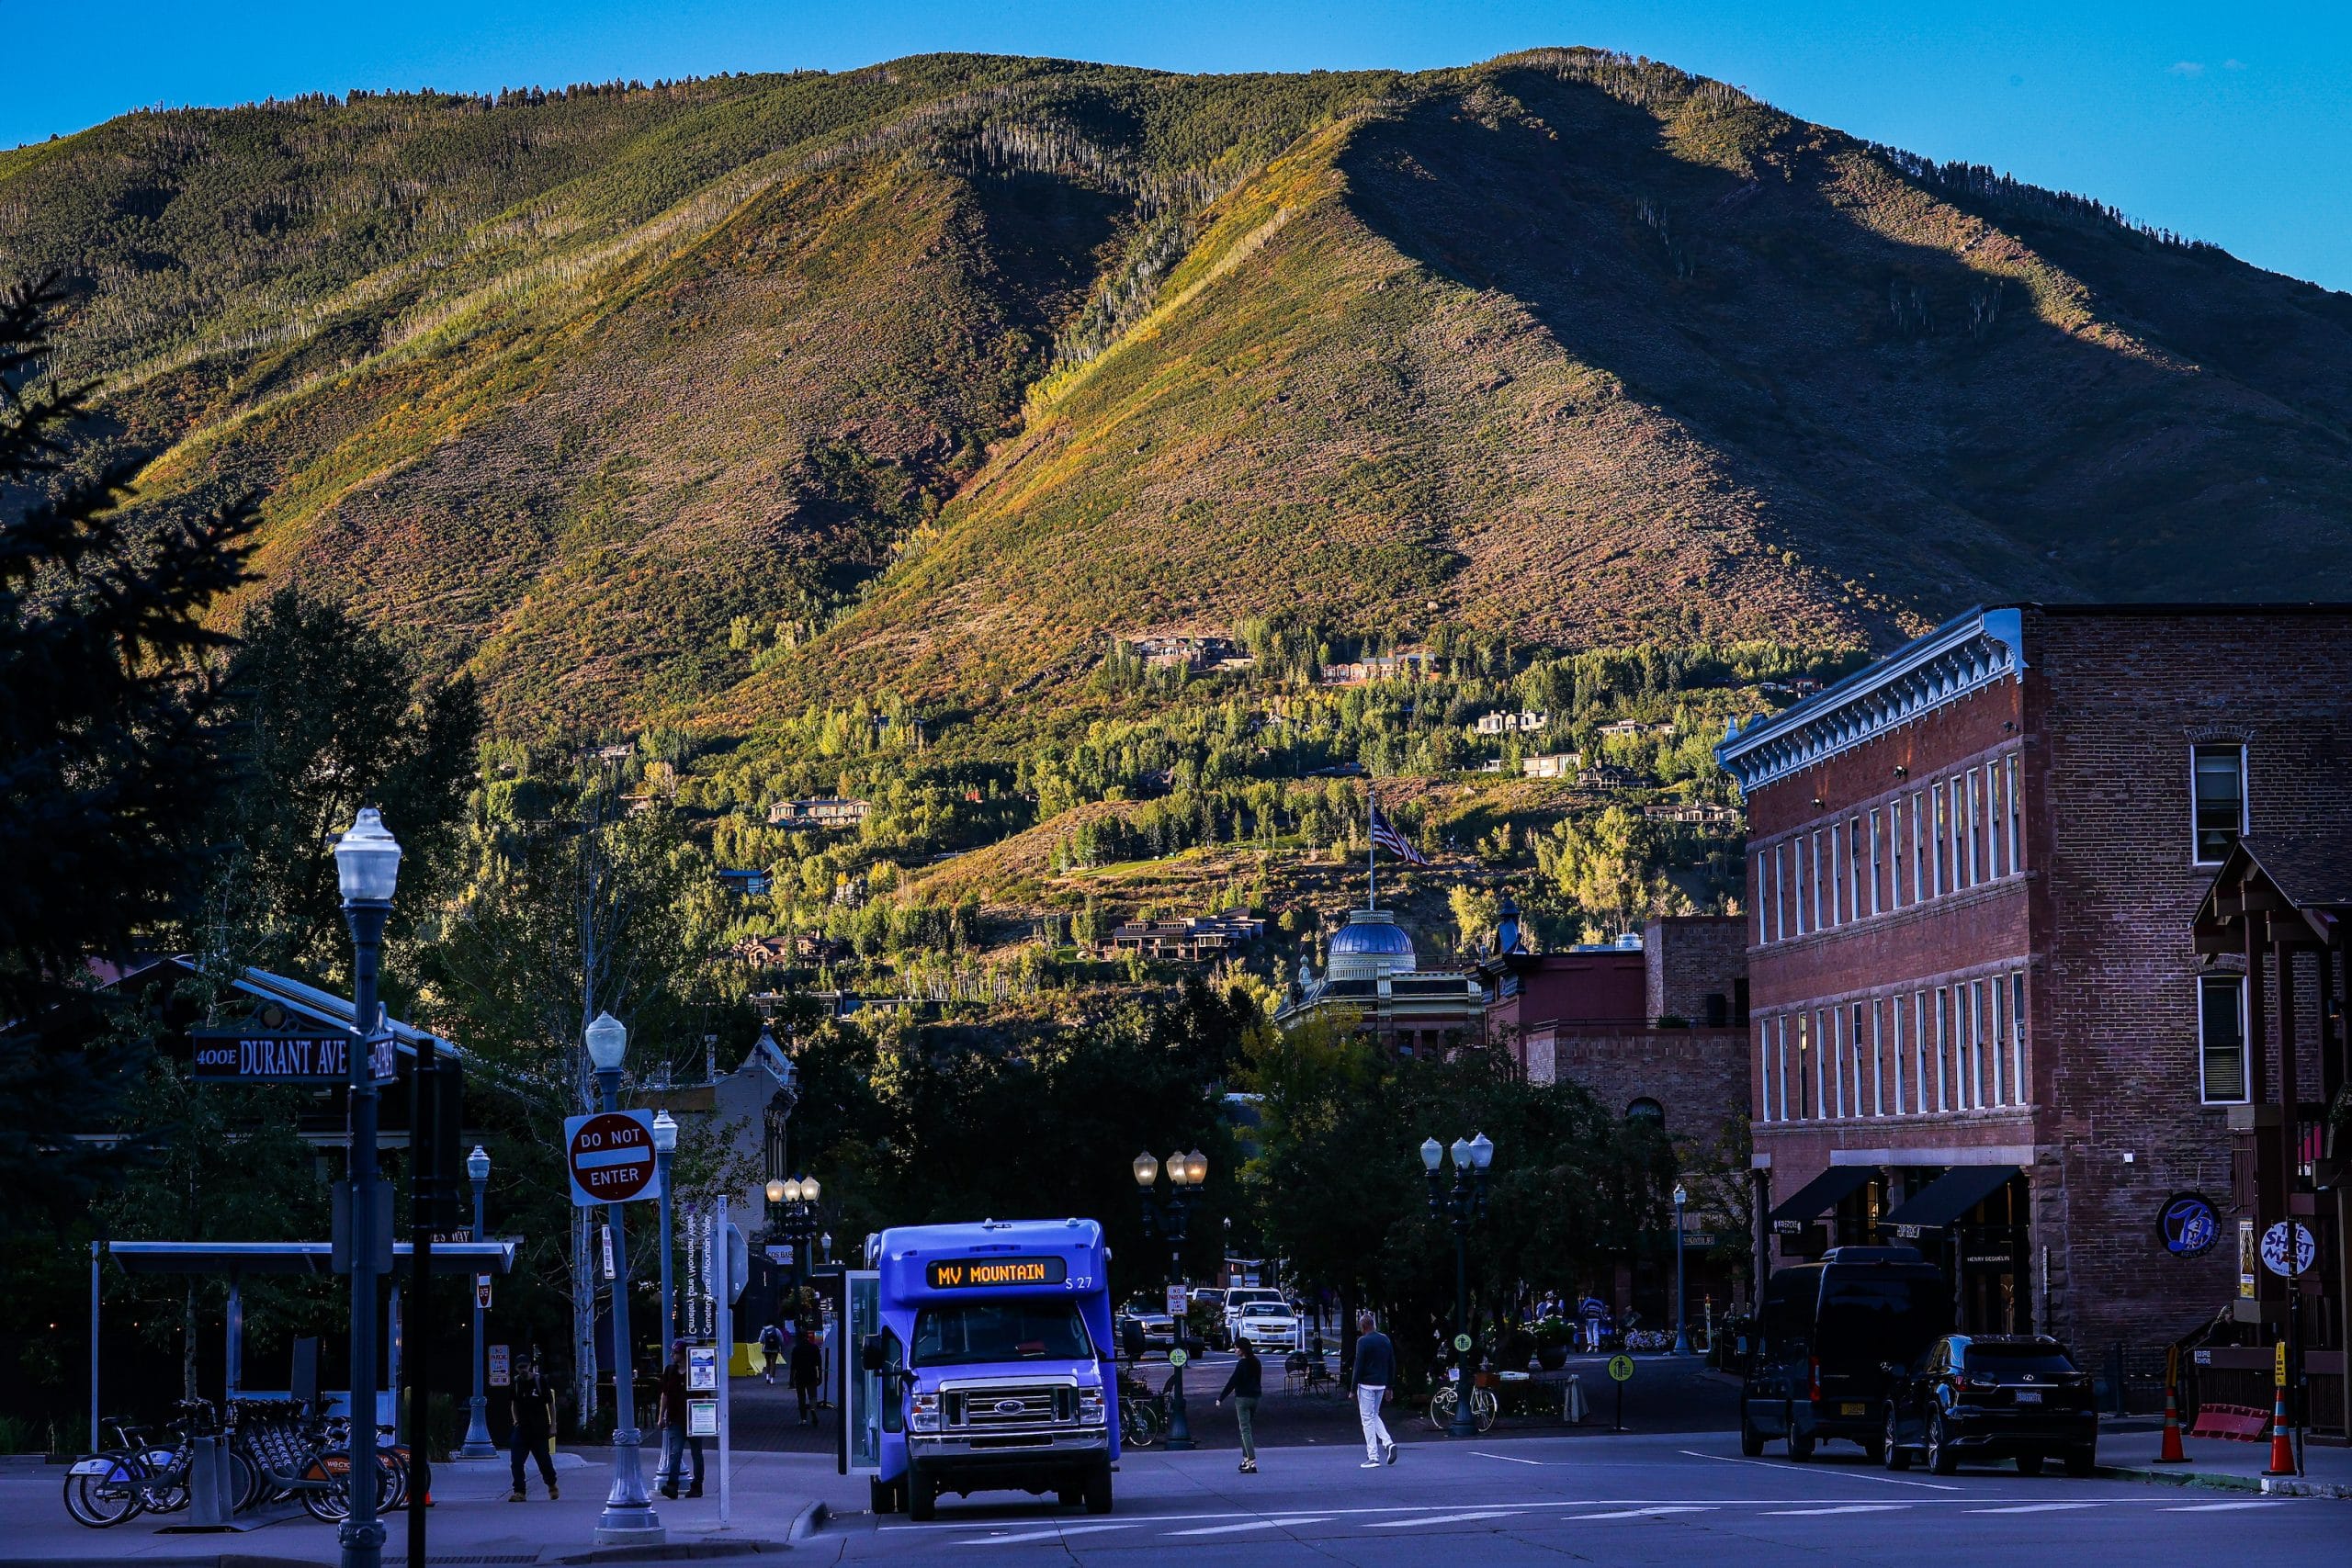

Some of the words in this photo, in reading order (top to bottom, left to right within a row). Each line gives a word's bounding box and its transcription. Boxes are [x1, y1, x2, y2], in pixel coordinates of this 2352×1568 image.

[197, 1049, 237, 1066] 400E
[240, 1040, 312, 1075] DURANT
[317, 1040, 347, 1075] AVE
[581, 1133, 602, 1147] DO
[610, 1128, 639, 1145] NOT
[590, 1168, 639, 1186] ENTER
[452, 1231, 470, 1243] WAY
[2280, 1224, 2304, 1240] TE
[2265, 1231, 2313, 1255] SHRT
[2263, 1247, 2309, 1269] MN
[937, 1266, 963, 1286] MV
[969, 1263, 1045, 1283] MOUNTAIN
[1065, 1278, 1073, 1290] S
[1077, 1277, 1092, 1289] 27
